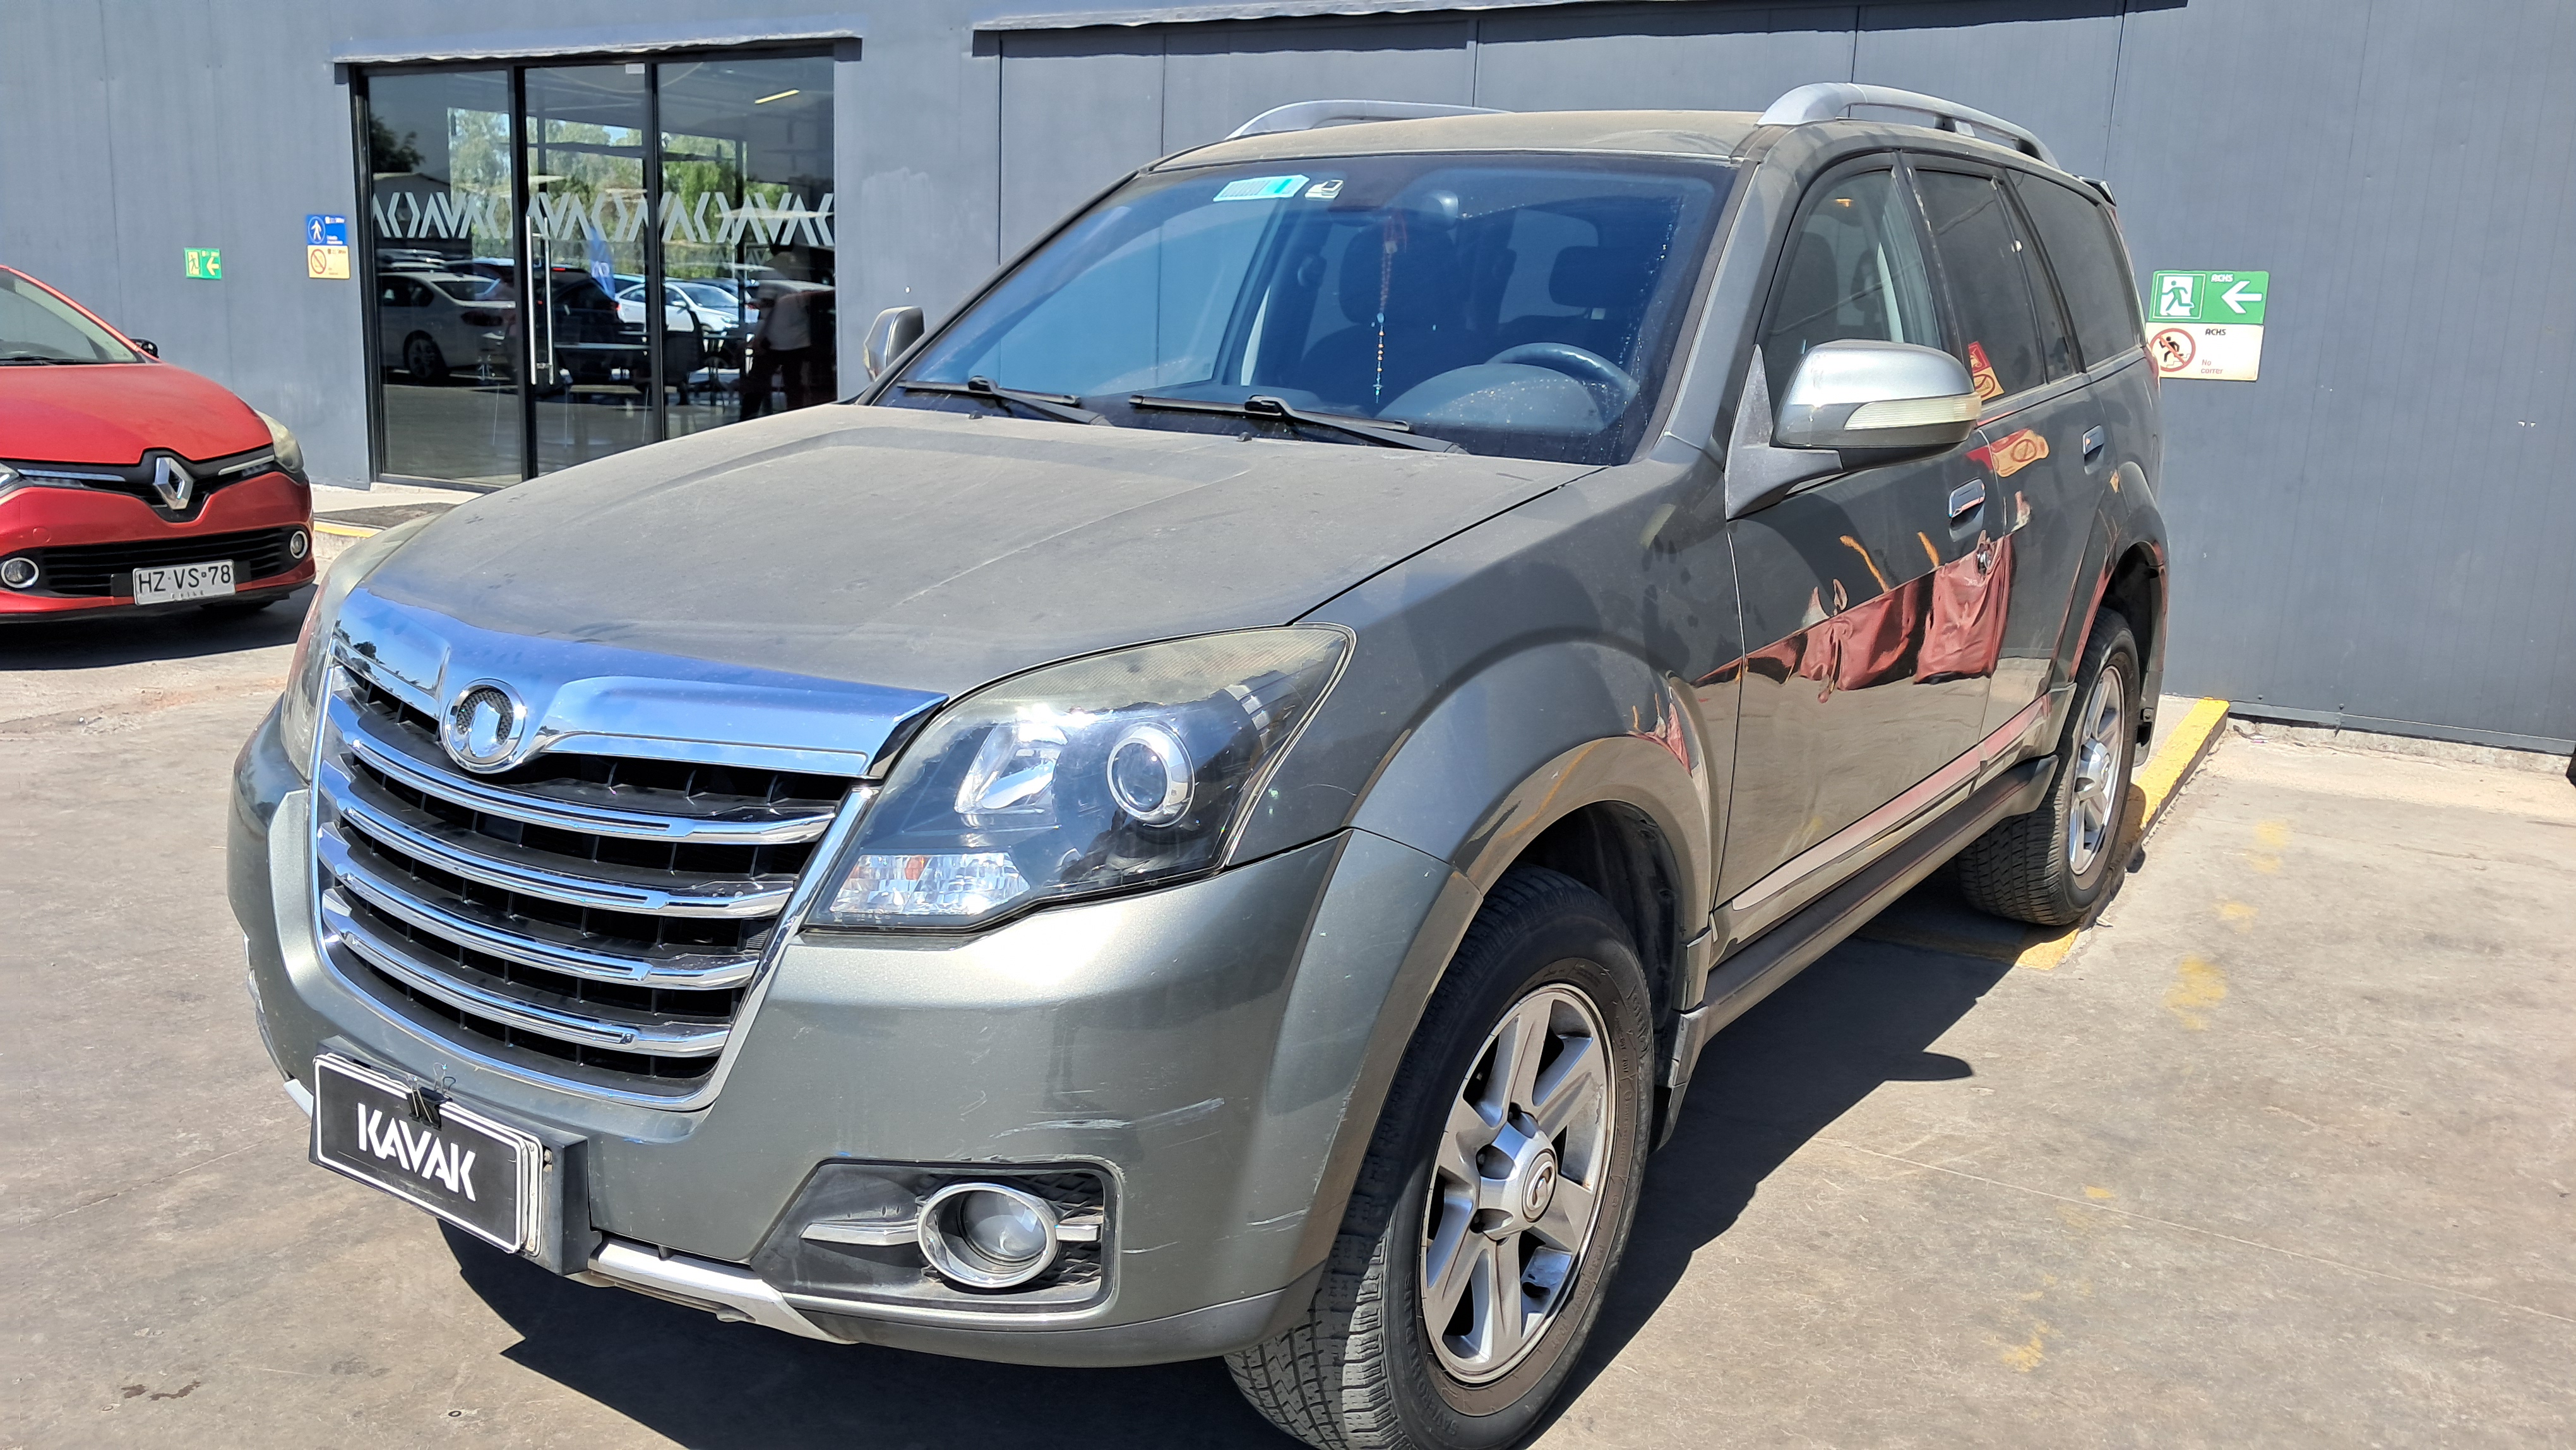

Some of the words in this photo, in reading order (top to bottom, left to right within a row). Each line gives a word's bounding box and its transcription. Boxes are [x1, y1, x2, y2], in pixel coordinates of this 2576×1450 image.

[2210, 273, 2234, 282] ACHS
[138, 571, 166, 594] HZ
[173, 568, 200, 589] VS
[208, 564, 231, 585] 78
[357, 1102, 476, 1202] KAVAK
[1404, 1271, 1414, 1346] PLUS
